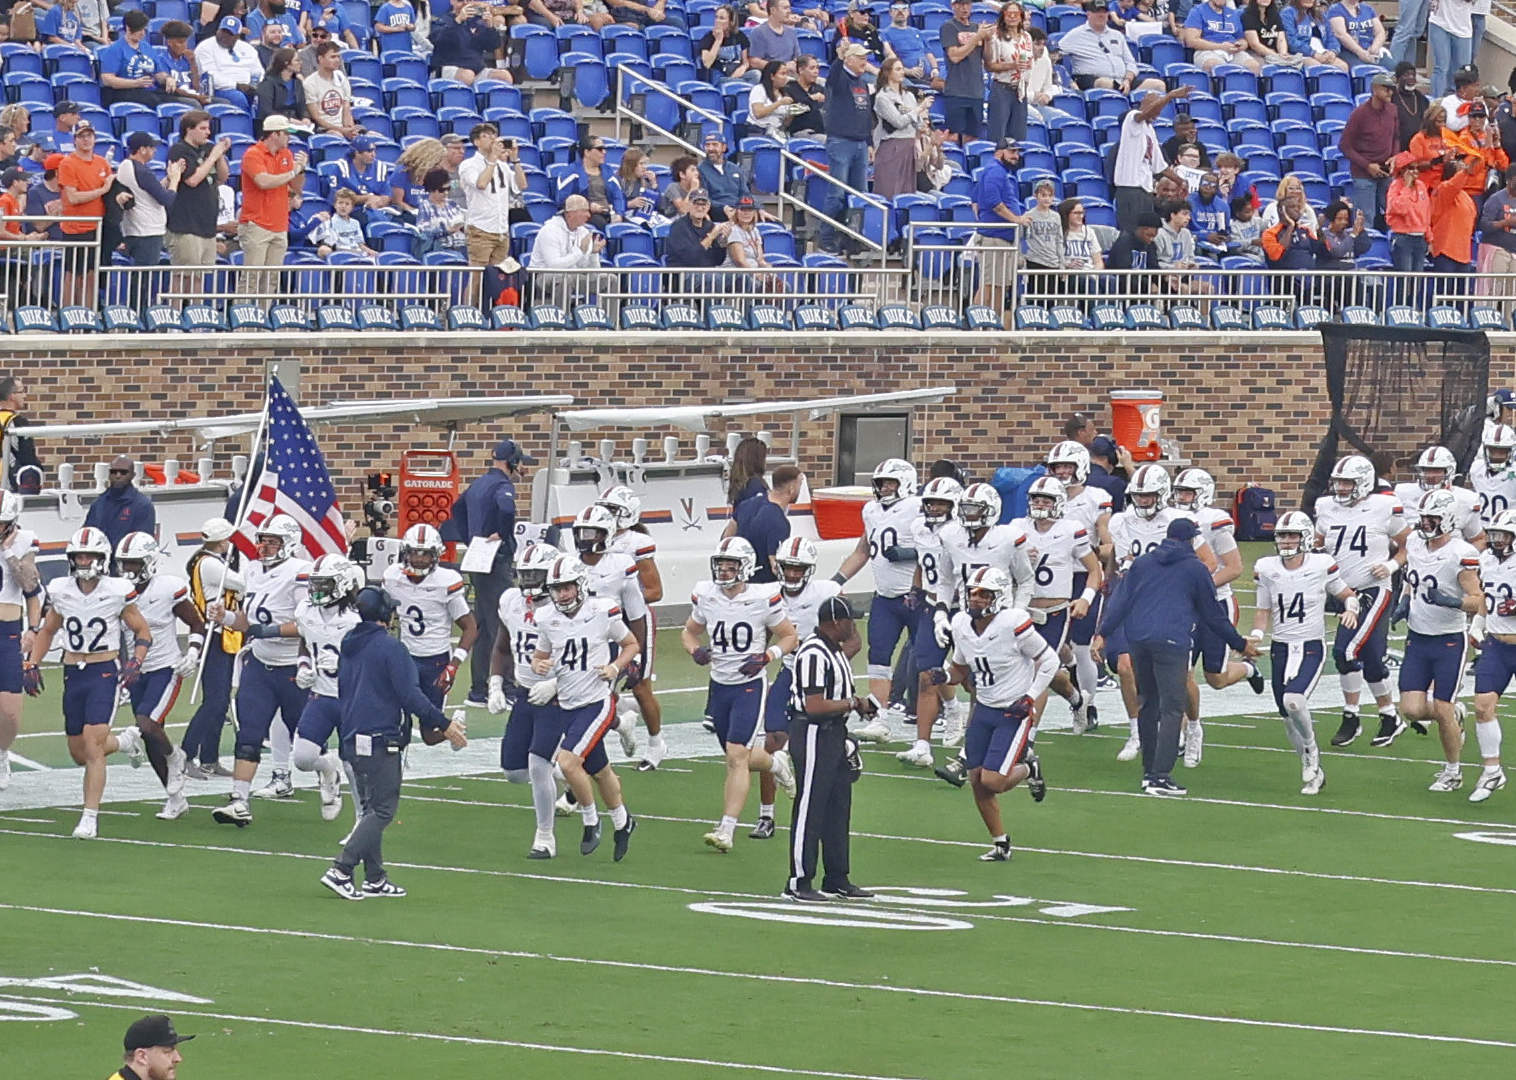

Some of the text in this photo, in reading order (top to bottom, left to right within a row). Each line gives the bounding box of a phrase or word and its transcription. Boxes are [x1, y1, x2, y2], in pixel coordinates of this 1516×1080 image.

[19, 308, 51, 324] DUKE
[64, 308, 95, 324] DUKE
[107, 308, 137, 324] DUKE
[150, 308, 181, 324] DUKE
[187, 308, 218, 324] DUKE
[233, 308, 264, 324] DUKE
[274, 308, 305, 324] DUKE
[319, 308, 351, 324] DUKE
[360, 308, 391, 324] DUKE
[404, 308, 434, 324] DUKE
[452, 308, 482, 324] DUKE
[495, 308, 524, 324] DUKE
[536, 308, 565, 324] DUKE
[577, 308, 605, 324] DUKE
[625, 308, 655, 324] DUKE
[666, 308, 697, 324] DUKE
[710, 308, 741, 324] DUKE
[754, 308, 784, 324] DUKE
[799, 308, 829, 324] DUKE
[844, 308, 873, 324] DUKE
[884, 308, 913, 324] DUKE
[927, 308, 955, 324] DUKE
[970, 308, 996, 324] DUKE
[1019, 308, 1049, 324] DUKE
[1054, 308, 1083, 324] DUKE
[1096, 308, 1124, 324] DUKE
[1130, 308, 1160, 324] DUKE
[1173, 308, 1200, 324] DUKE
[1214, 308, 1242, 324] DUKE
[1256, 308, 1286, 324] DUKE
[1299, 308, 1328, 324] DUKE
[1346, 310, 1375, 325] DUKE
[1388, 310, 1419, 325] DUKE
[1432, 310, 1461, 325] DUKE
[1473, 310, 1502, 325] DUKE
[403, 480, 454, 489] GATORADE
[1330, 524, 1368, 557] 74
[1035, 553, 1053, 587] 6
[1407, 569, 1438, 604] 93
[244, 591, 273, 625] 76
[1277, 592, 1306, 624] 14
[406, 605, 426, 637] 3
[66, 616, 109, 652] 82
[713, 620, 753, 654] 40
[516, 631, 536, 664] 15
[561, 637, 588, 672] 41
[974, 656, 995, 687] 11
